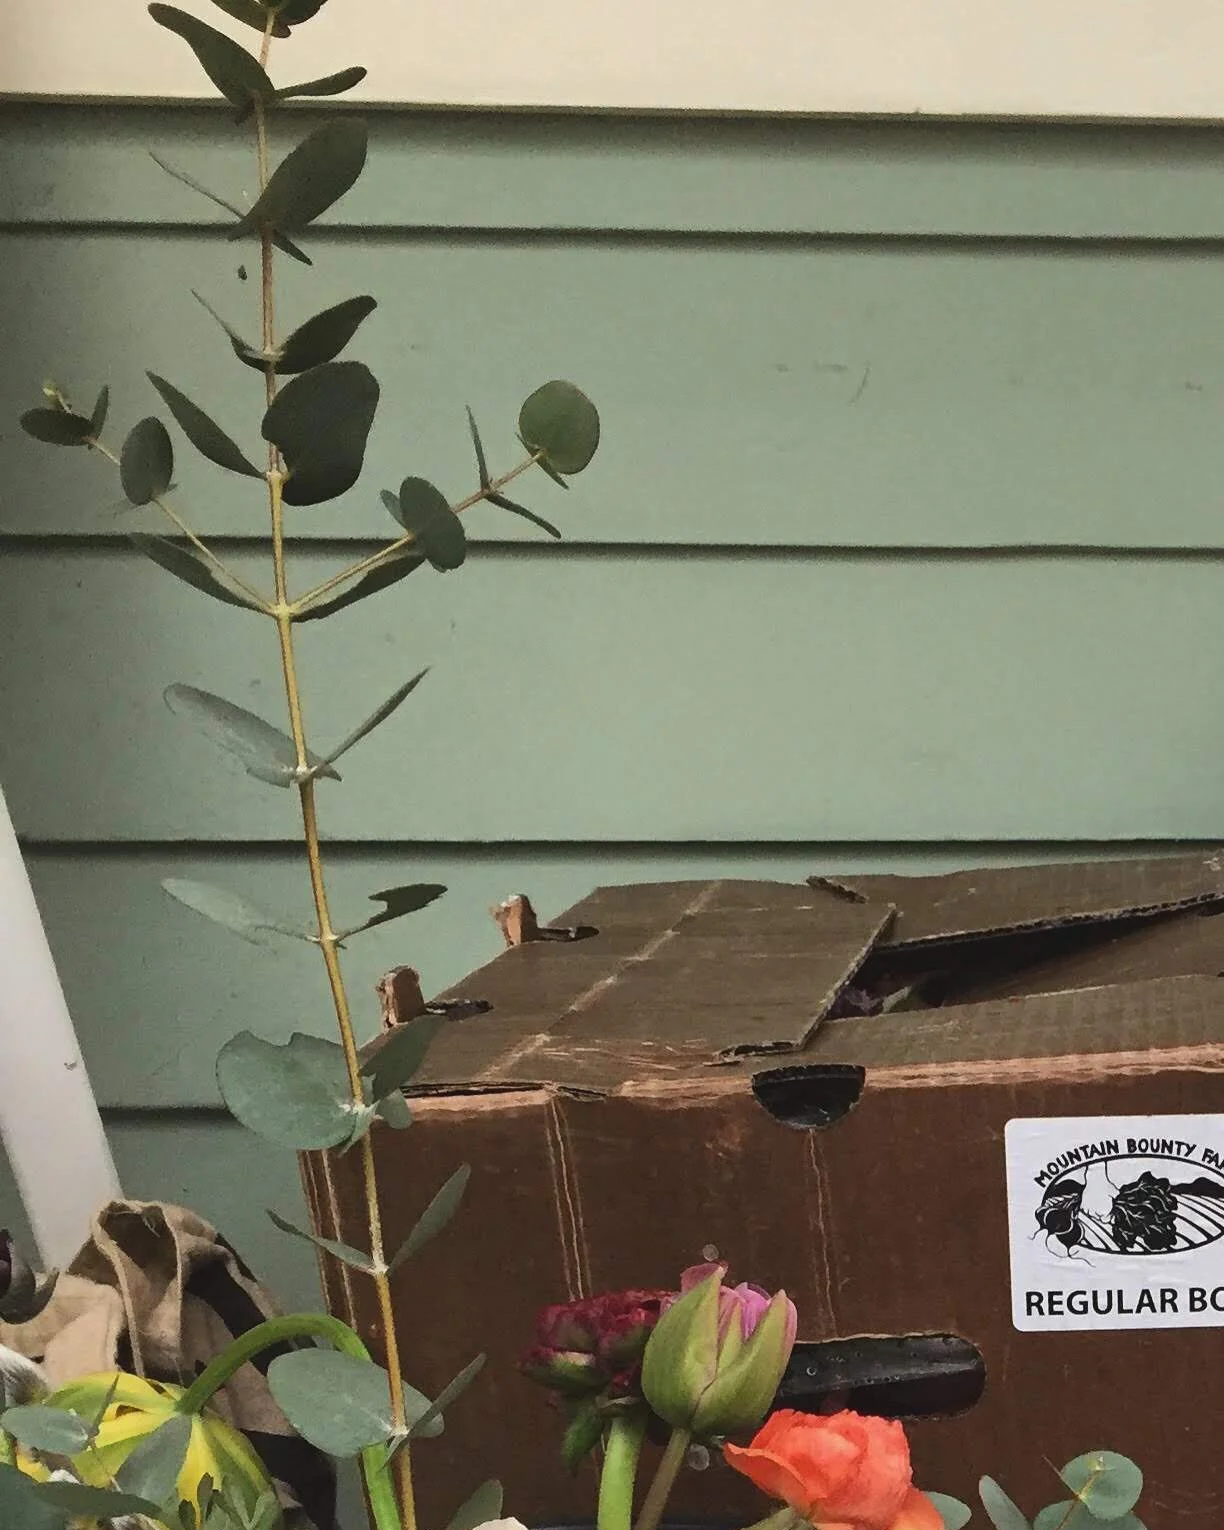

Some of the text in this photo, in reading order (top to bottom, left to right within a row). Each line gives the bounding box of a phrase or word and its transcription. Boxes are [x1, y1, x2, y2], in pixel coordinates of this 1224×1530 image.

[1034, 1139, 1120, 1188] MOUNTAIN
[1126, 1138, 1197, 1158] BOUNTY
[1025, 1288, 1180, 1317] REGULAR
